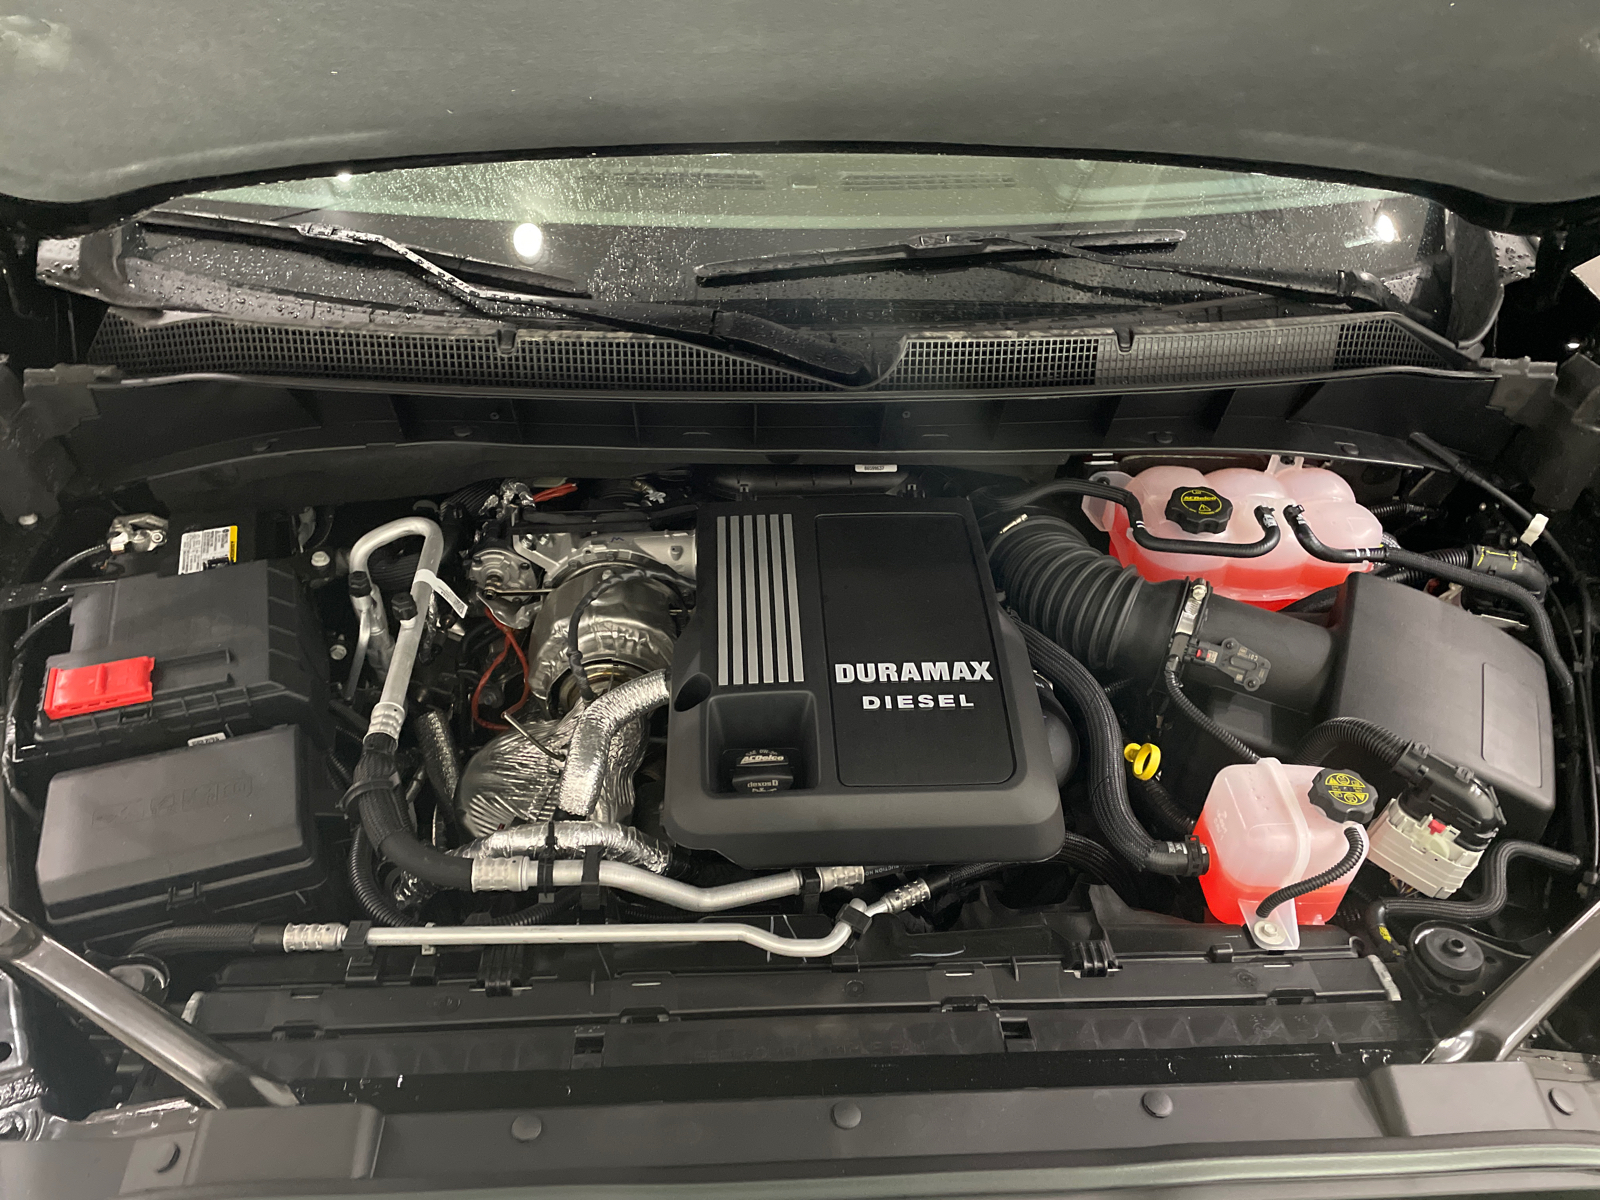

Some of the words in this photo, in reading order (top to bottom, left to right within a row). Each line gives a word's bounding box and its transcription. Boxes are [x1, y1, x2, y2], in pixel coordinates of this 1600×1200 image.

[835, 661, 994, 683] DURAMAX
[862, 694, 975, 710] DIESEL
[740, 755, 784, 764] ACDelco
